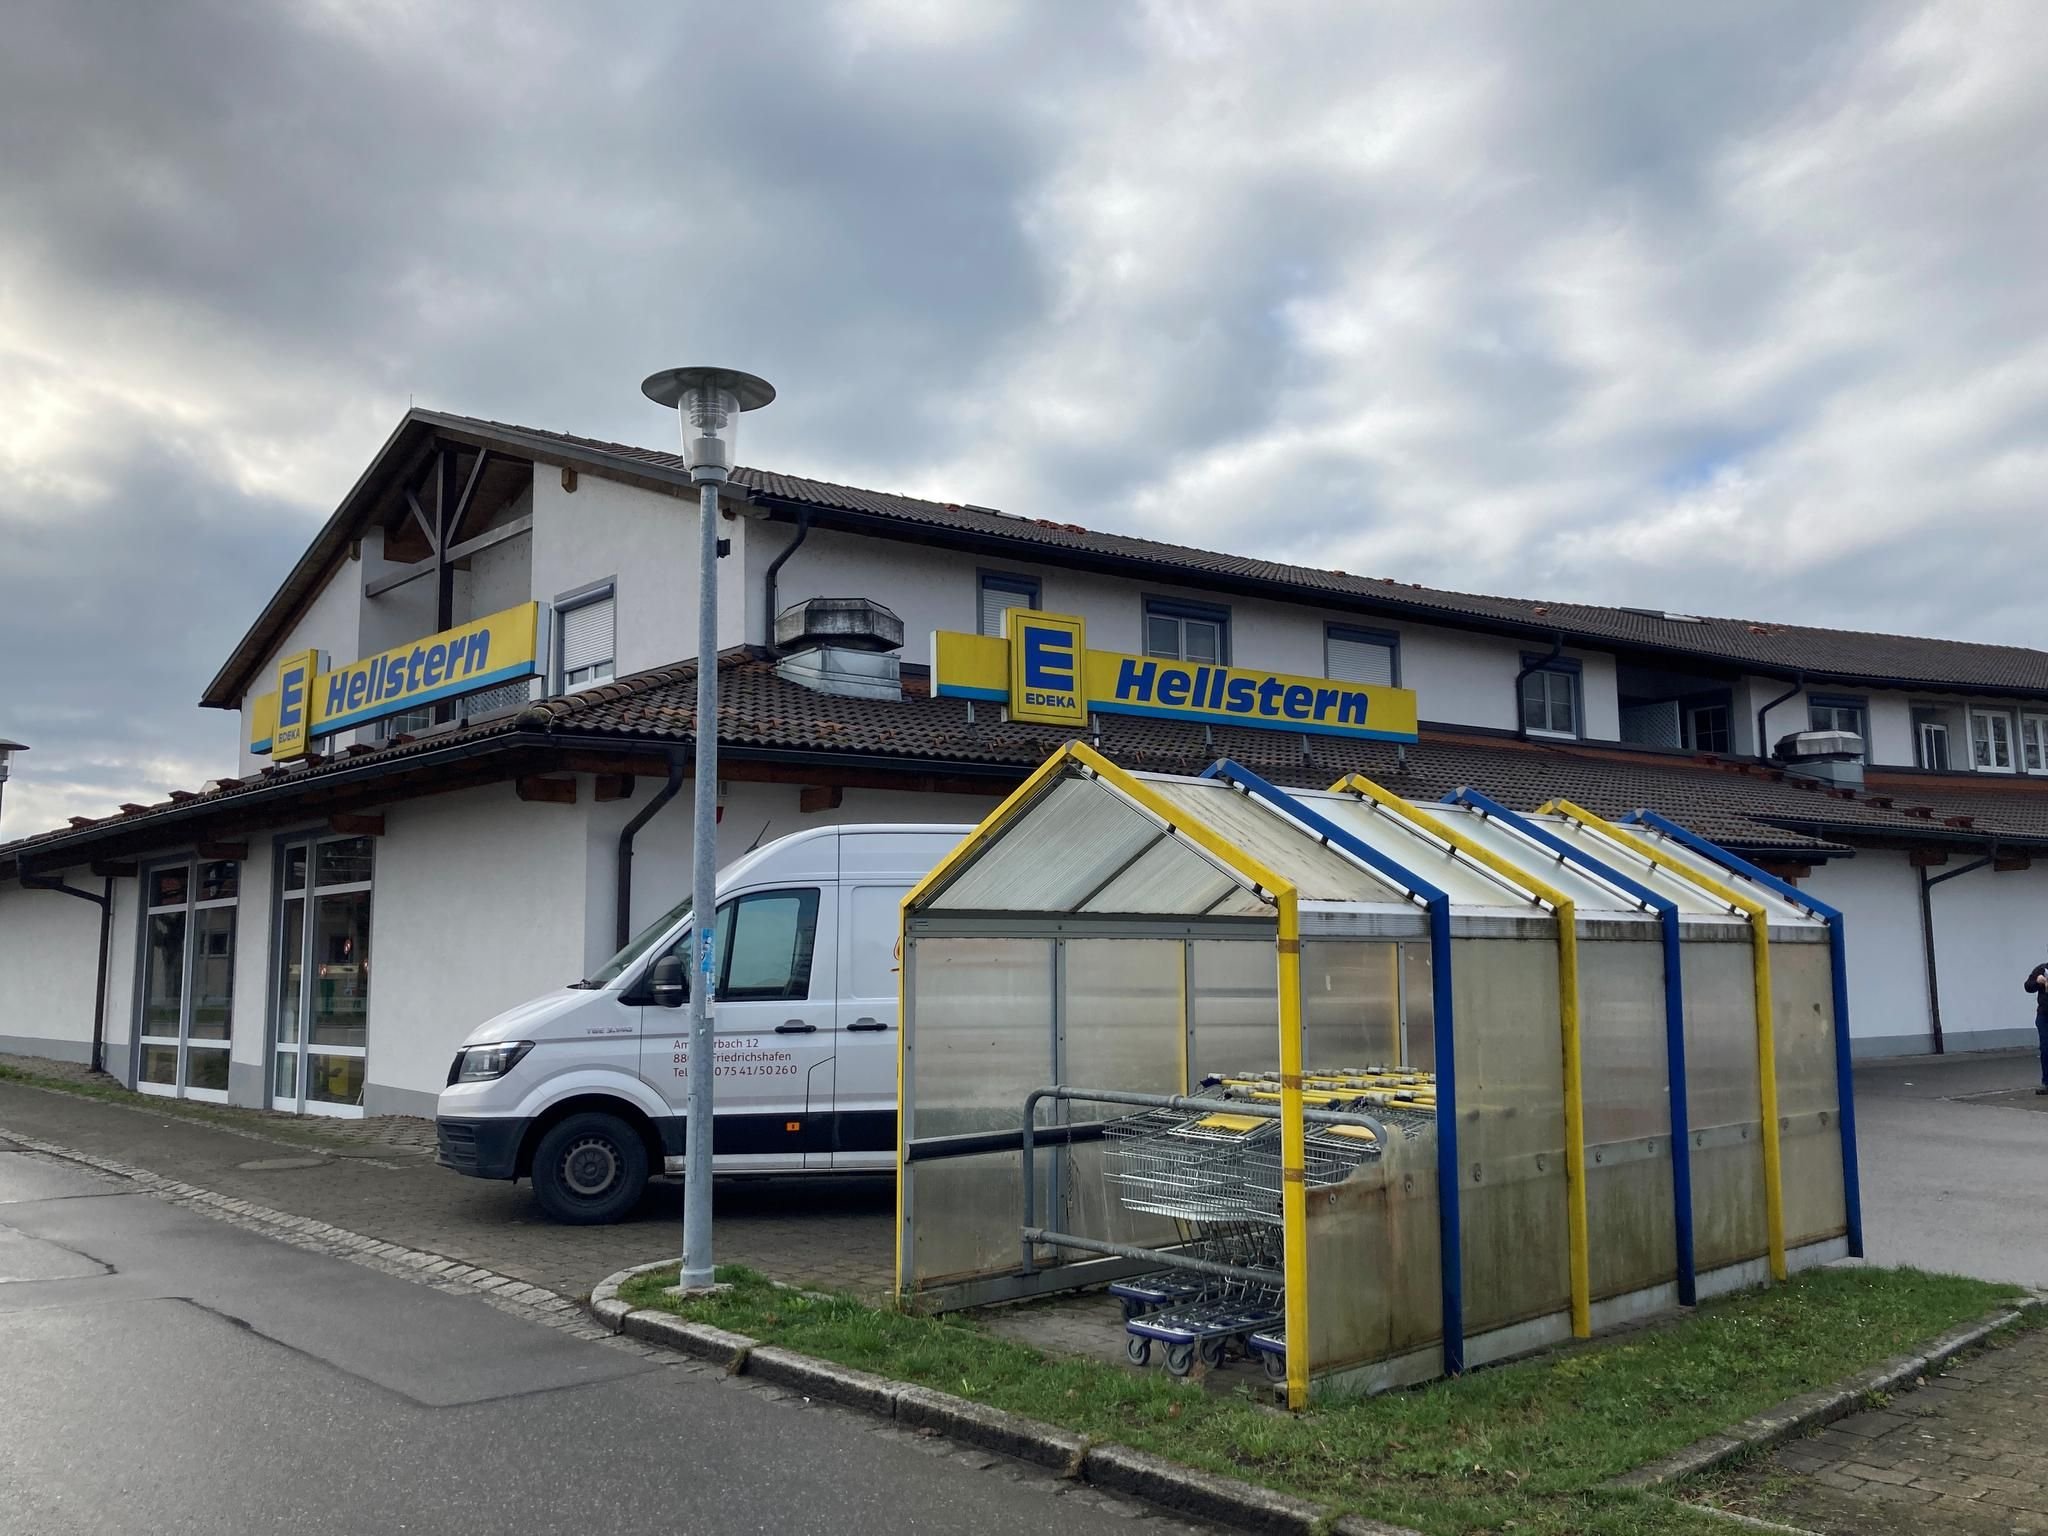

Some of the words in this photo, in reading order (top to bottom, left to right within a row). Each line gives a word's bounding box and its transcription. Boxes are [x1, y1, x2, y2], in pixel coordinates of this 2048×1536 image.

[326, 630, 490, 716] Hellstern
[1025, 627, 1074, 691] E
[280, 667, 304, 727] E
[1025, 693, 1076, 709] EDEKA
[1116, 659, 1368, 725] Hellstern
[279, 728, 301, 744] EDEKA
[747, 1038, 759, 1048] 12
